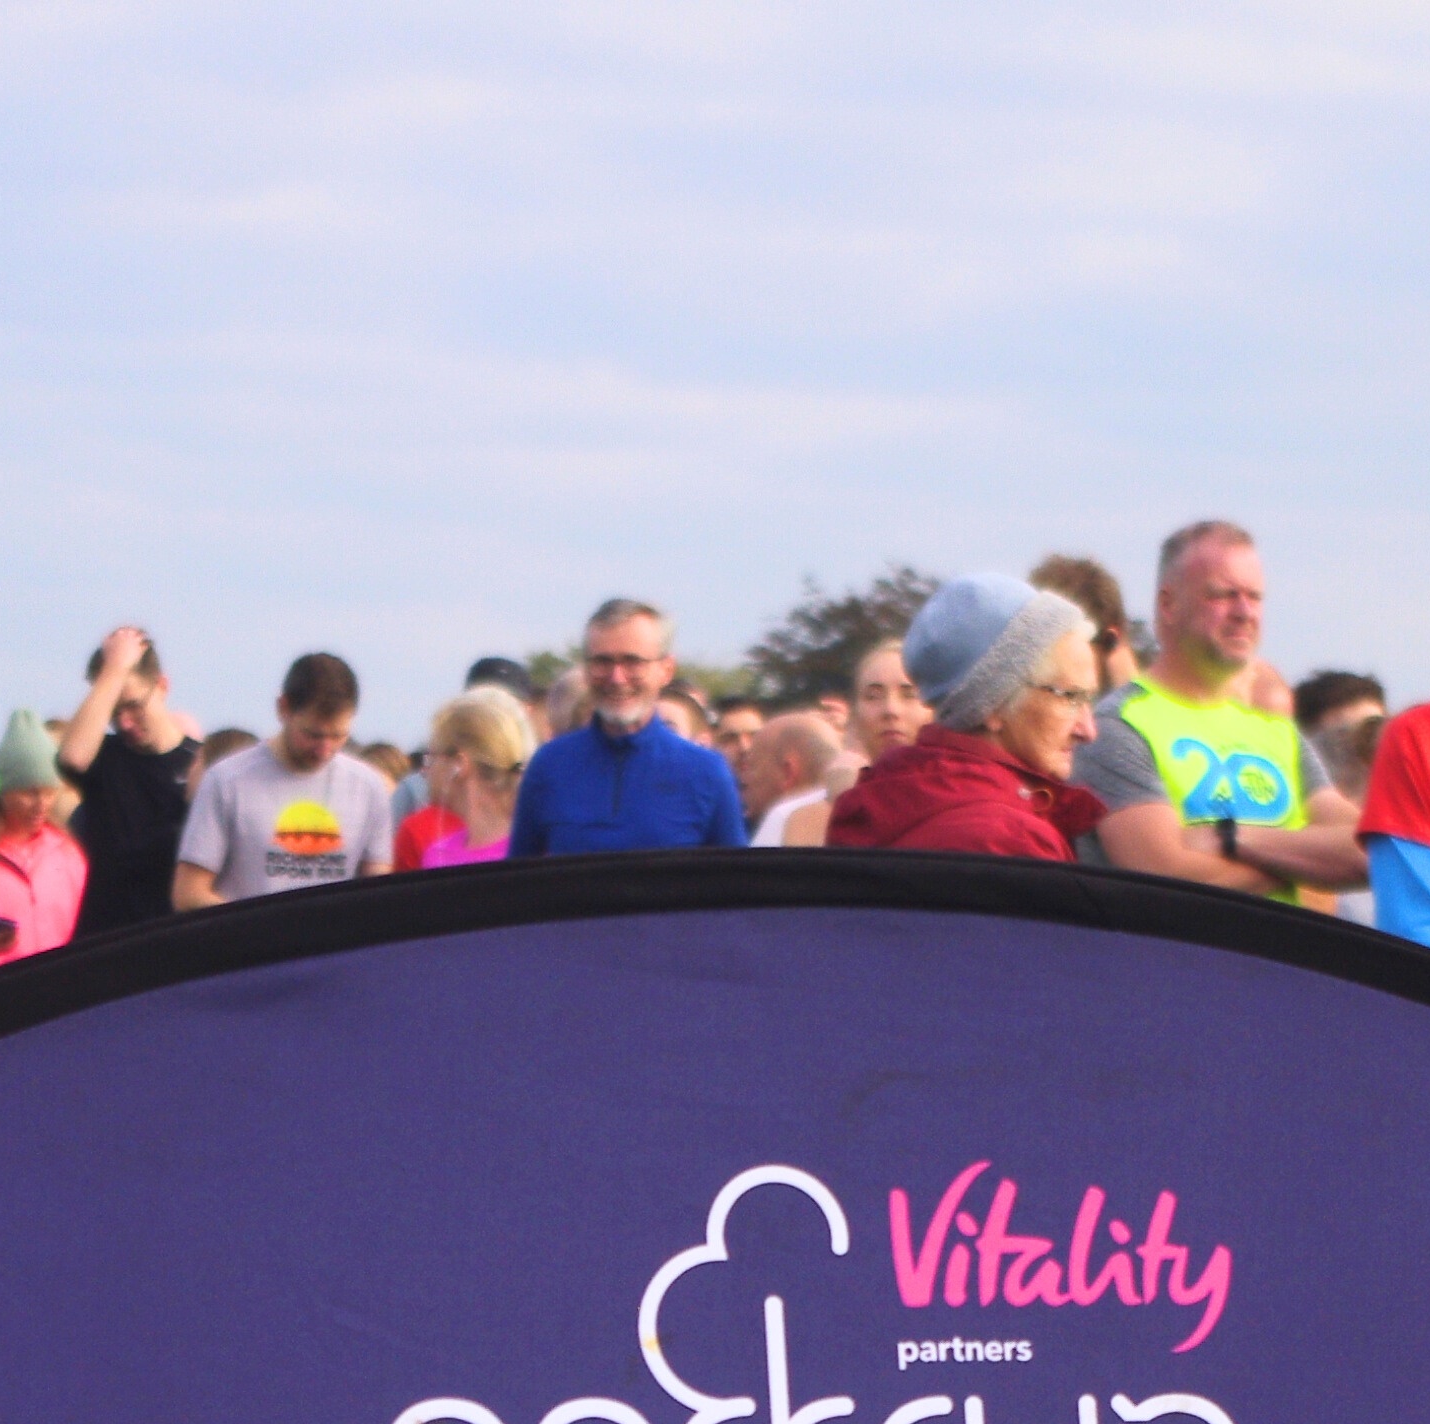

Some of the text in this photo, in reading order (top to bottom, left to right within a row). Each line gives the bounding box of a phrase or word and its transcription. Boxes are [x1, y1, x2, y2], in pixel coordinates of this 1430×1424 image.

[1171, 737, 1290, 821] 20
[889, 1161, 1232, 1353] Vitality
[897, 1336, 1033, 1371] partners
